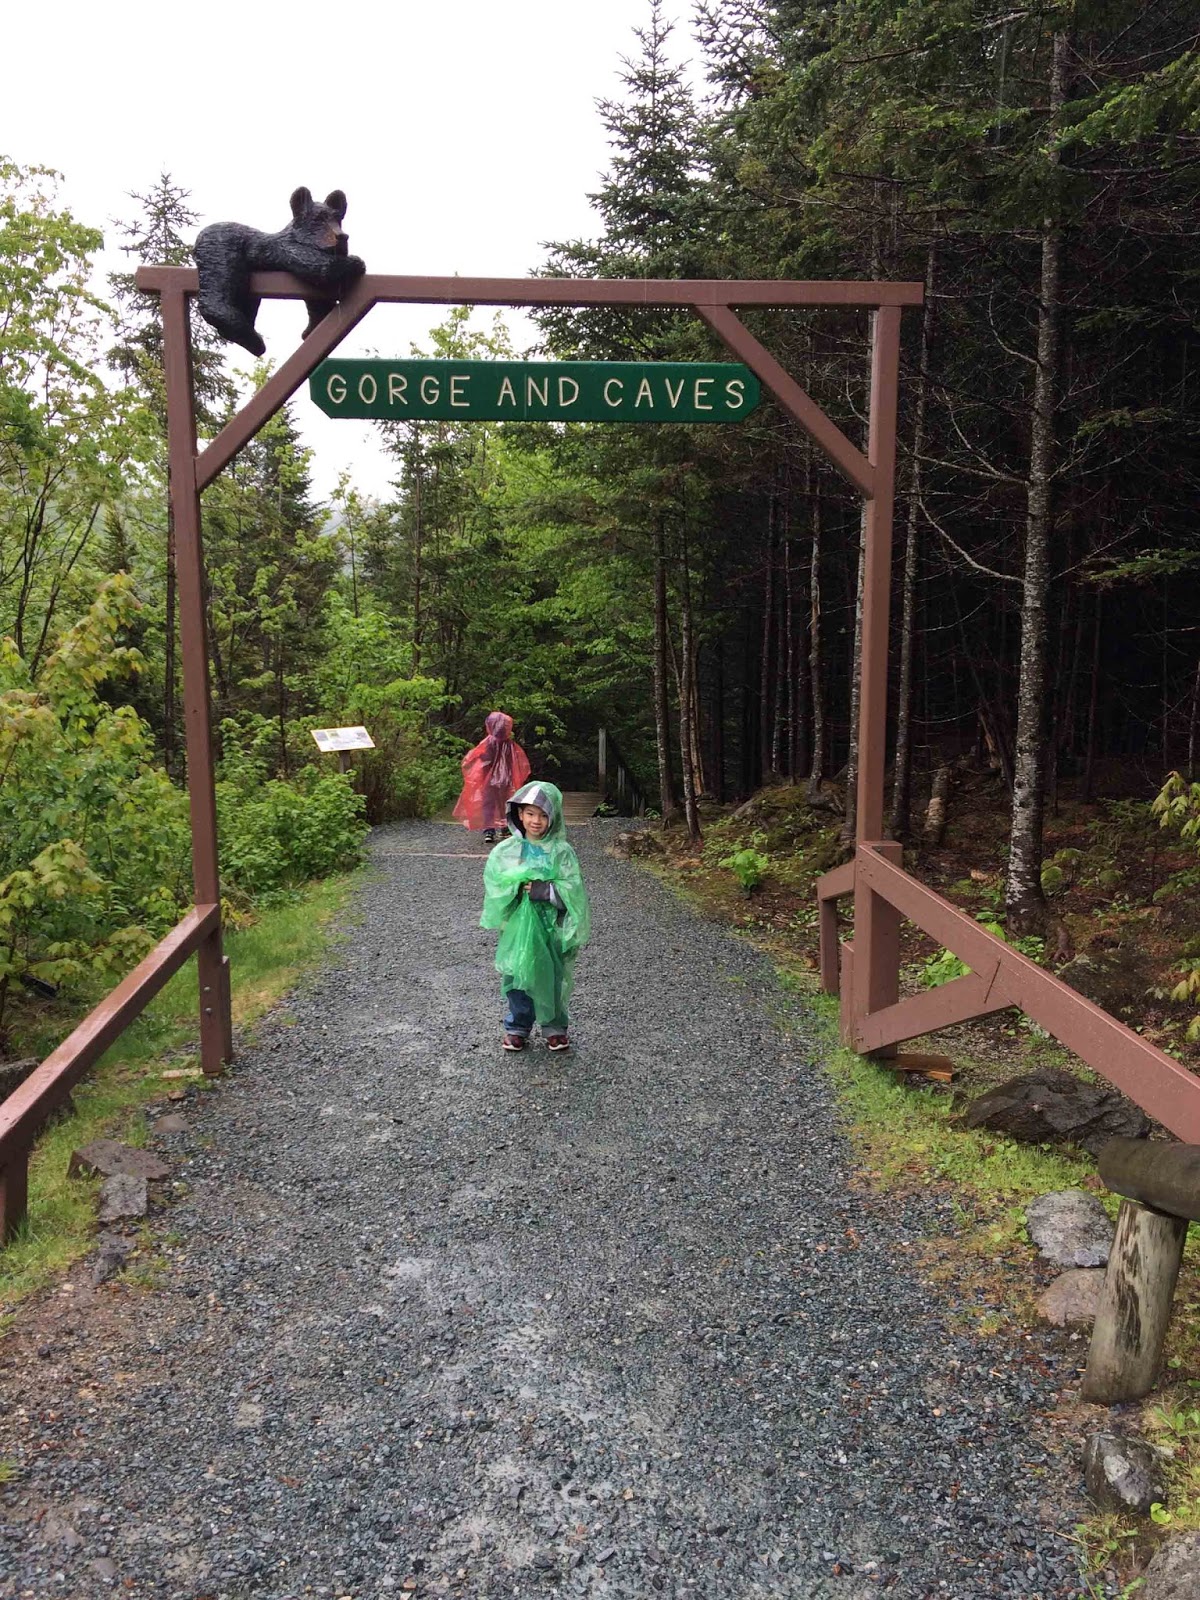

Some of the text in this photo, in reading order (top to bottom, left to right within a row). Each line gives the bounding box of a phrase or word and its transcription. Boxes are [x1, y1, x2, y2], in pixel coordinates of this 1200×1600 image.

[326, 374, 745, 410] GORGE AND CAVES
